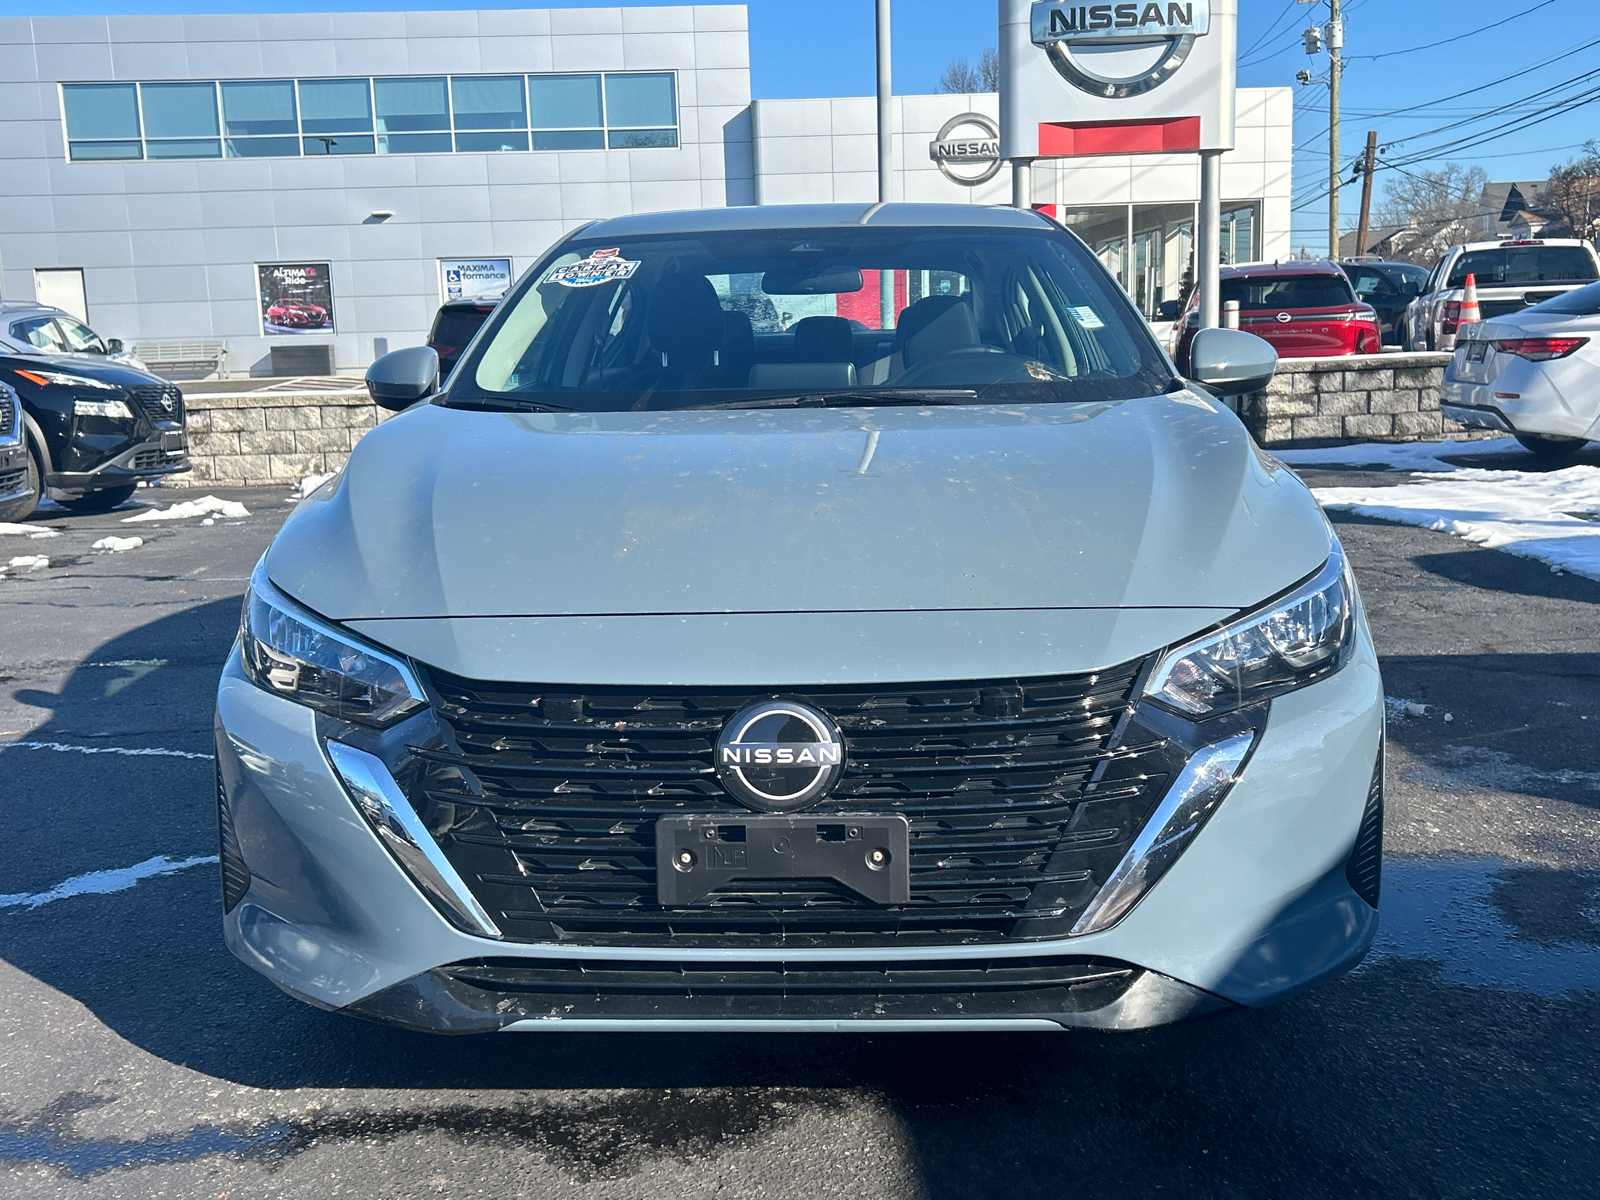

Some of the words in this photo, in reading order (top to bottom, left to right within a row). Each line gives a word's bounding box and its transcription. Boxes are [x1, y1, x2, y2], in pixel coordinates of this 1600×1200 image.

[1050, 2, 1193, 33] NISSAN
[273, 267, 316, 277] ALTIMATE
[457, 264, 495, 272] MAXIMA
[556, 263, 631, 274] CARFAX
[461, 272, 506, 280] formance
[564, 270, 628, 279] OWNER
[285, 277, 306, 285] Ride
[1254, 327, 1329, 335] URANO
[723, 747, 837, 763] NISSAN
